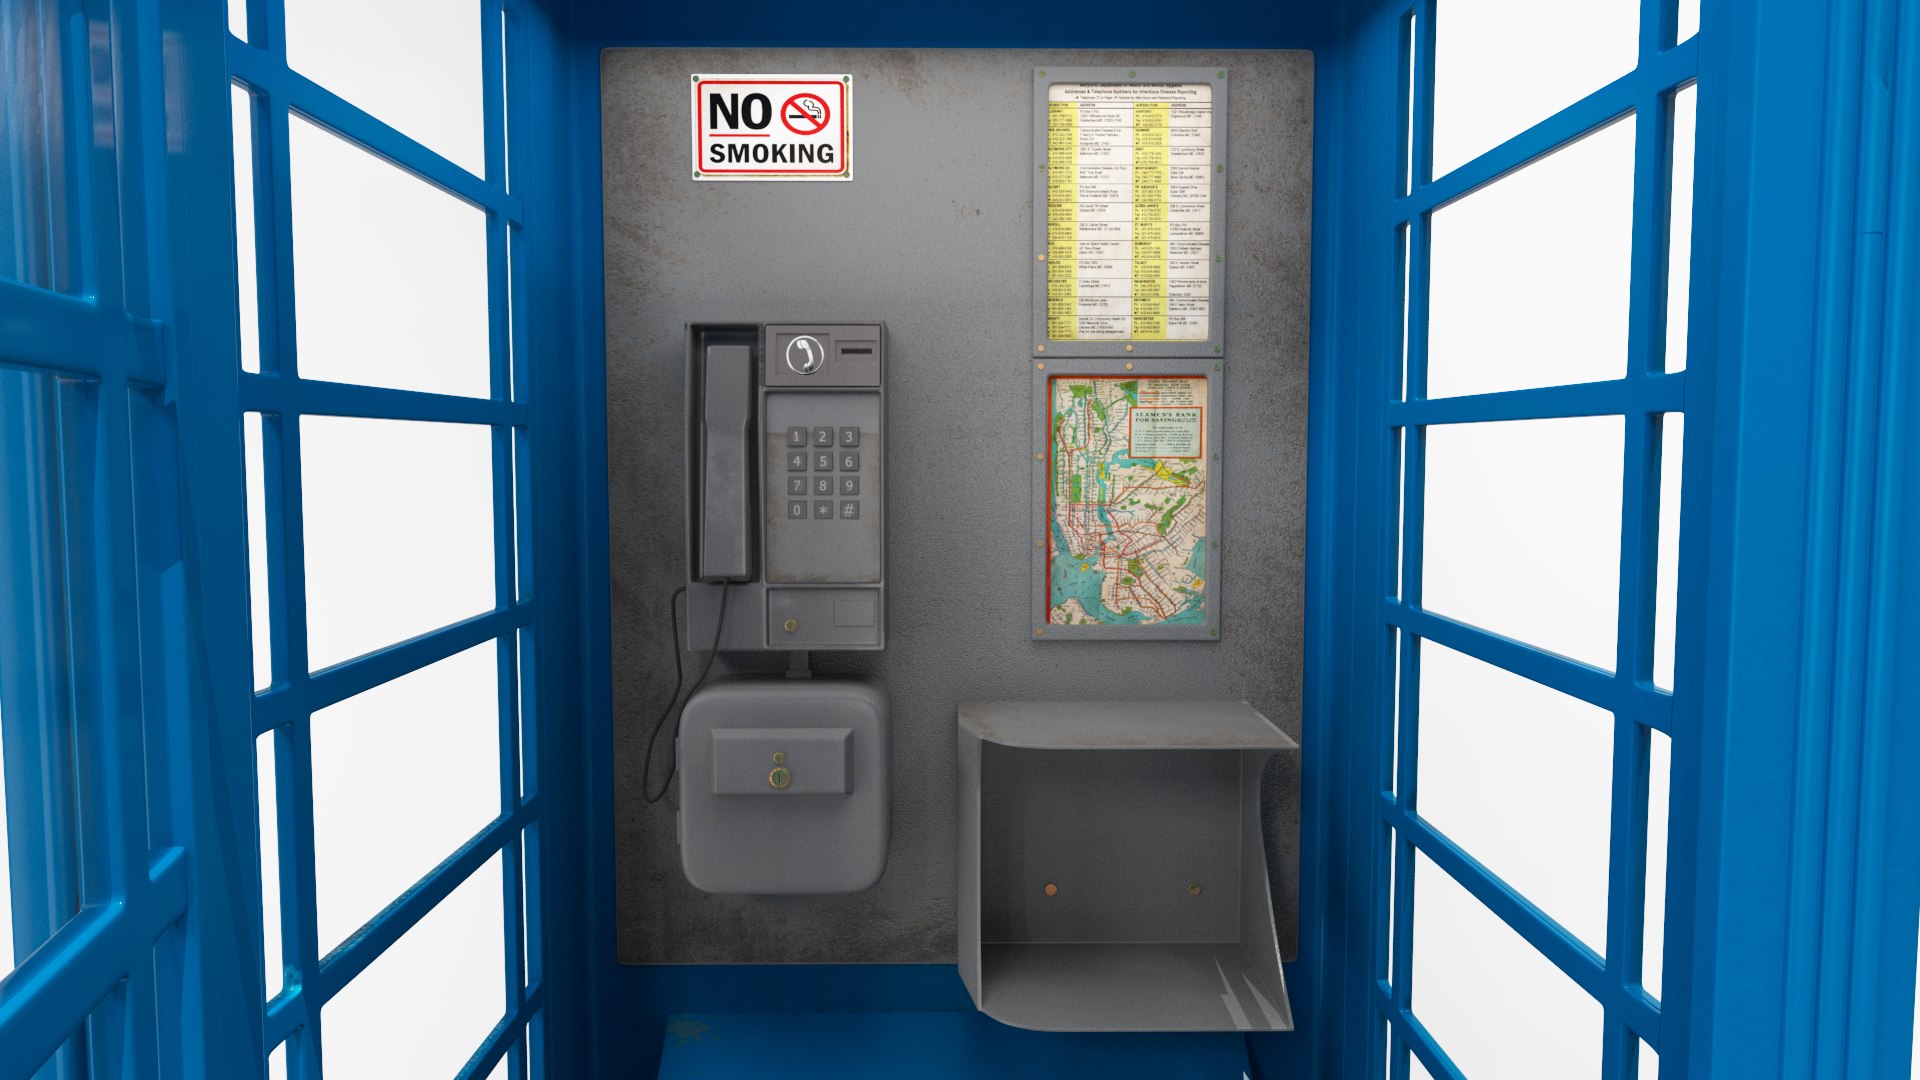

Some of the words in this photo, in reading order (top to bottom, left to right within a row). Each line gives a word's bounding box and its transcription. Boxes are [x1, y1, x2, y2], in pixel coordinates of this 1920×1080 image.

[709, 92, 772, 130] NO
[709, 143, 834, 164] SMOKING
[793, 430, 800, 442] 1
[819, 431, 827, 442] 2
[845, 431, 853, 443] 3
[793, 456, 801, 467] 4
[820, 456, 827, 467] 5
[845, 456, 853, 468] 6
[793, 480, 801, 491] 7
[819, 480, 827, 491] 8
[845, 480, 853, 492] 9
[843, 503, 854, 517] #
